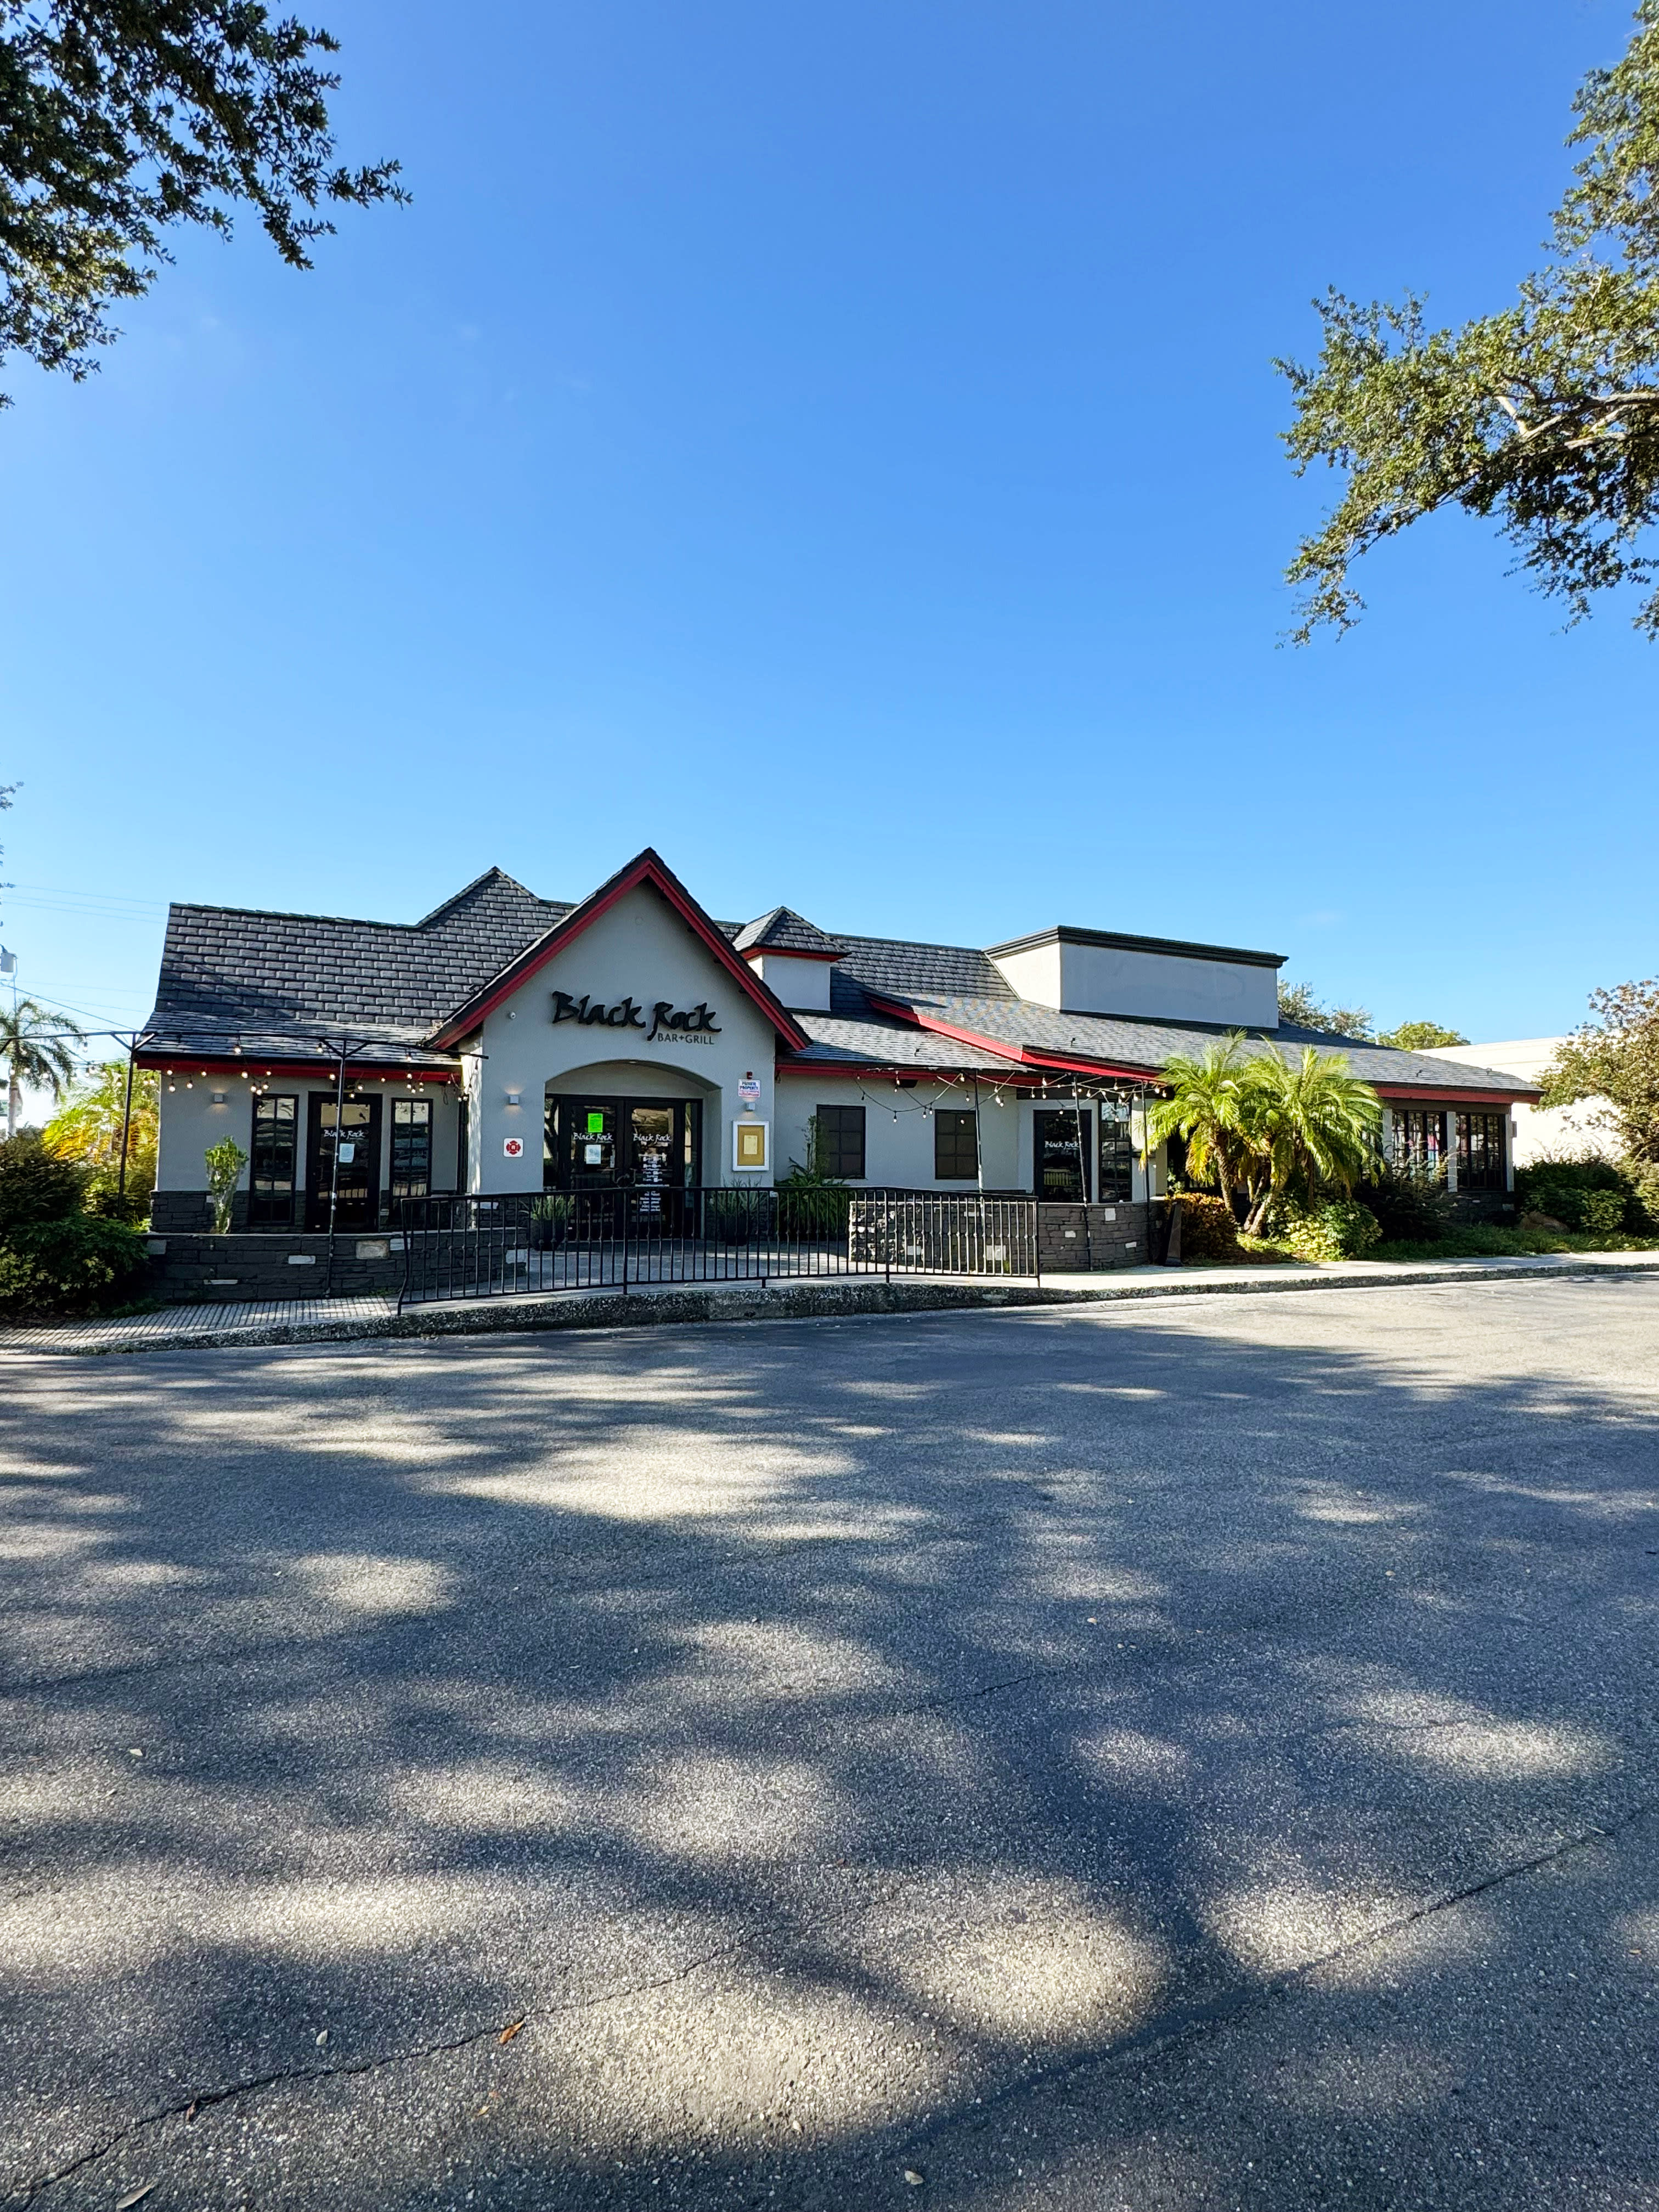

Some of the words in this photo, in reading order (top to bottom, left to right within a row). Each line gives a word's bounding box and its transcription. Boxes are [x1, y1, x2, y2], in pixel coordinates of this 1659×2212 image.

[552, 990, 646, 1028] Black
[647, 1001, 722, 1041] Rock
[658, 1032, 714, 1045] BAR+GRILL
[324, 1129, 346, 1137] Blak
[346, 1129, 365, 1140] Rock
[573, 1132, 595, 1140] Black
[595, 1132, 613, 1143] Rock
[633, 1133, 654, 1141] Black
[653, 1133, 672, 1144] Rock
[1063, 1141, 1080, 1150] Rock
